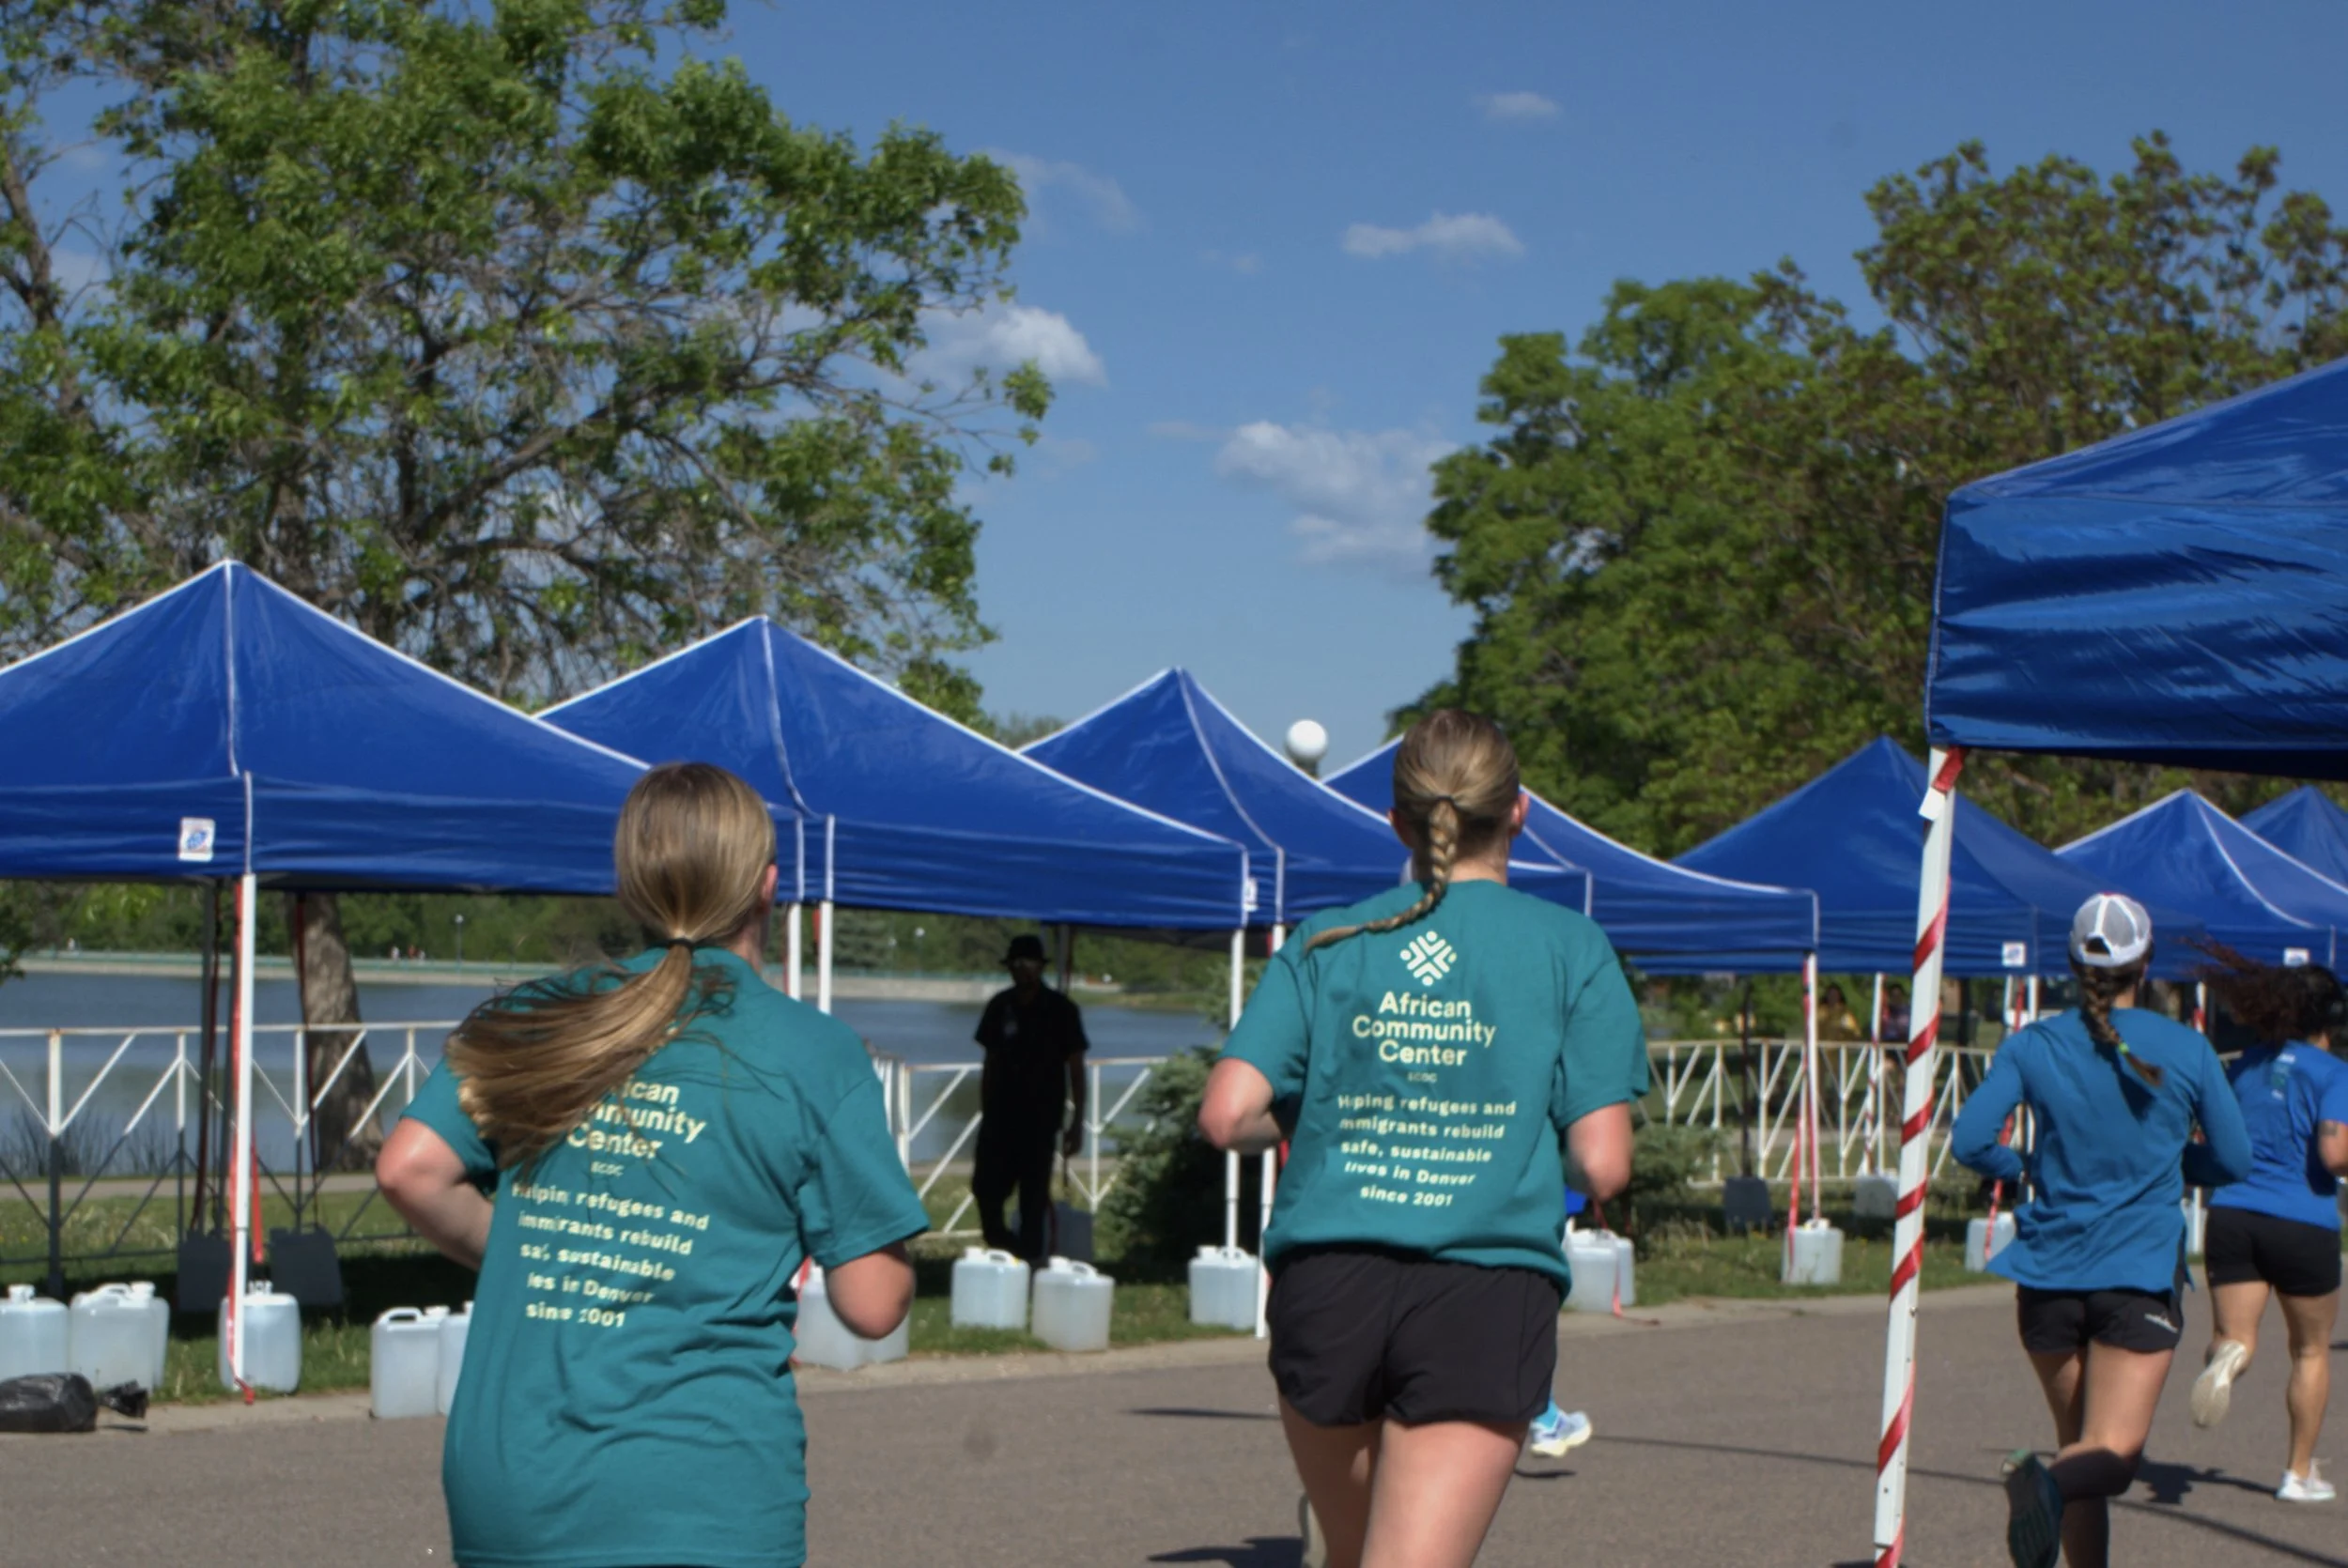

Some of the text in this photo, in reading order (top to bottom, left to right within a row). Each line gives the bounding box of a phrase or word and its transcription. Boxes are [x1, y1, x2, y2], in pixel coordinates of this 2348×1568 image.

[1378, 991, 1472, 1019] African
[1352, 1015, 1496, 1048] Community
[1379, 1038, 1467, 1066] Center
[612, 1074, 680, 1104] ican
[1400, 1096, 1477, 1117] refugees
[1483, 1100, 1517, 1116] and
[587, 1101, 706, 1144] munity
[1339, 1115, 1506, 1139] mmigrants rebuild
[567, 1123, 663, 1159] Center
[1340, 1139, 1492, 1162] safe, sustainable
[1393, 1164, 1411, 1181] in
[1415, 1168, 1476, 1186] Denver
[1359, 1184, 1453, 1207] since 2001
[575, 1192, 665, 1219] refugees
[670, 1209, 710, 1231] and
[518, 1209, 693, 1255] immrants rebuild
[557, 1248, 675, 1282] sustainable
[582, 1279, 655, 1302] Denver
[526, 1301, 573, 1320] sine
